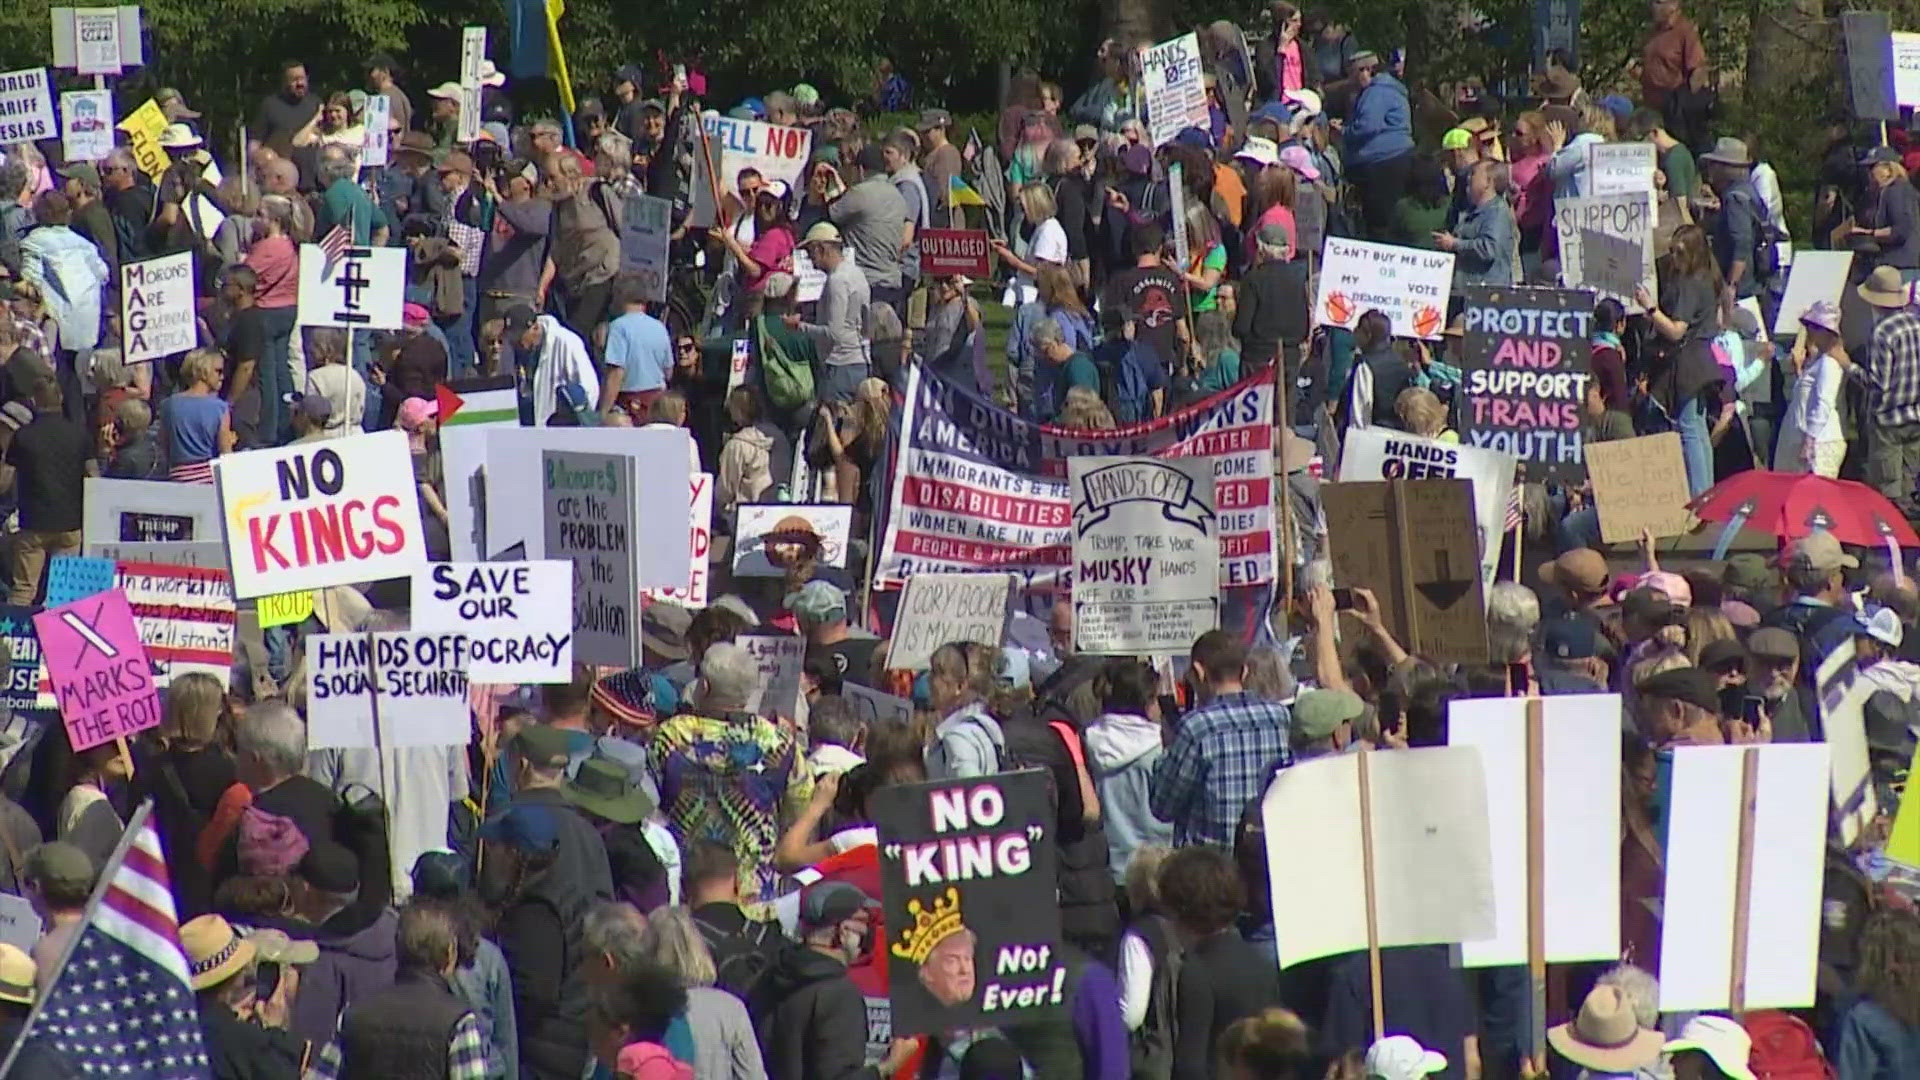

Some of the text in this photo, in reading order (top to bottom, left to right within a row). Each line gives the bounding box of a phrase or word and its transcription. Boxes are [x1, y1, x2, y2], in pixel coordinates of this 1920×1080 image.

[1143, 37, 1187, 73] HANDS
[0, 72, 41, 92] ORLD!
[0, 97, 38, 116] ARIFF
[0, 119, 46, 140] ESLAS
[1561, 201, 1649, 238] SUPPORT
[921, 236, 986, 257] OUTRAGED
[1373, 251, 1397, 262] BUY
[1400, 255, 1418, 266] ME
[128, 287, 165, 311] ARE
[1341, 274, 1440, 296] MY VOTE
[1465, 306, 1594, 339] PROTECT
[1493, 337, 1563, 369] AND
[969, 401, 1031, 448] OUR
[1471, 397, 1580, 430] TRANS
[918, 415, 1031, 469] AMERICA
[1181, 432, 1251, 457] MATTER
[1384, 440, 1458, 465] HANDS
[1470, 429, 1582, 465] YOUTH
[276, 448, 345, 502] NO
[916, 455, 1024, 493] IMMIGRANTS
[1213, 457, 1256, 477] COME
[1087, 468, 1147, 505] HANDS
[557, 494, 608, 521] are the
[920, 483, 1250, 525] DISABILITIES TED
[248, 494, 406, 575] KINGS
[559, 520, 626, 553] PROBLEM
[909, 511, 1256, 545] WOMEN ARE IN CHA DIES
[1134, 534, 1165, 550] TAKE
[1168, 537, 1195, 552] YOUR
[912, 537, 967, 559] PEOPLE
[432, 564, 531, 601] SAVE
[591, 555, 614, 584] the
[1079, 555, 1197, 586] MUSKY HANDS
[459, 597, 518, 621] OUR
[912, 583, 1006, 619] CORY BOOKE
[181, 628, 230, 649] stand
[469, 632, 571, 668] OCRACY
[903, 621, 920, 651] IS
[922, 620, 951, 650] MY
[319, 635, 470, 670] HANDS OFF
[61, 658, 147, 714] MARKS
[387, 668, 471, 704] SECURITY
[68, 692, 158, 746] THE ROT
[931, 783, 1005, 833] NO
[885, 824, 1044, 887] "KING"
[996, 944, 1051, 975] Not
[982, 967, 1067, 1013] Ever!
